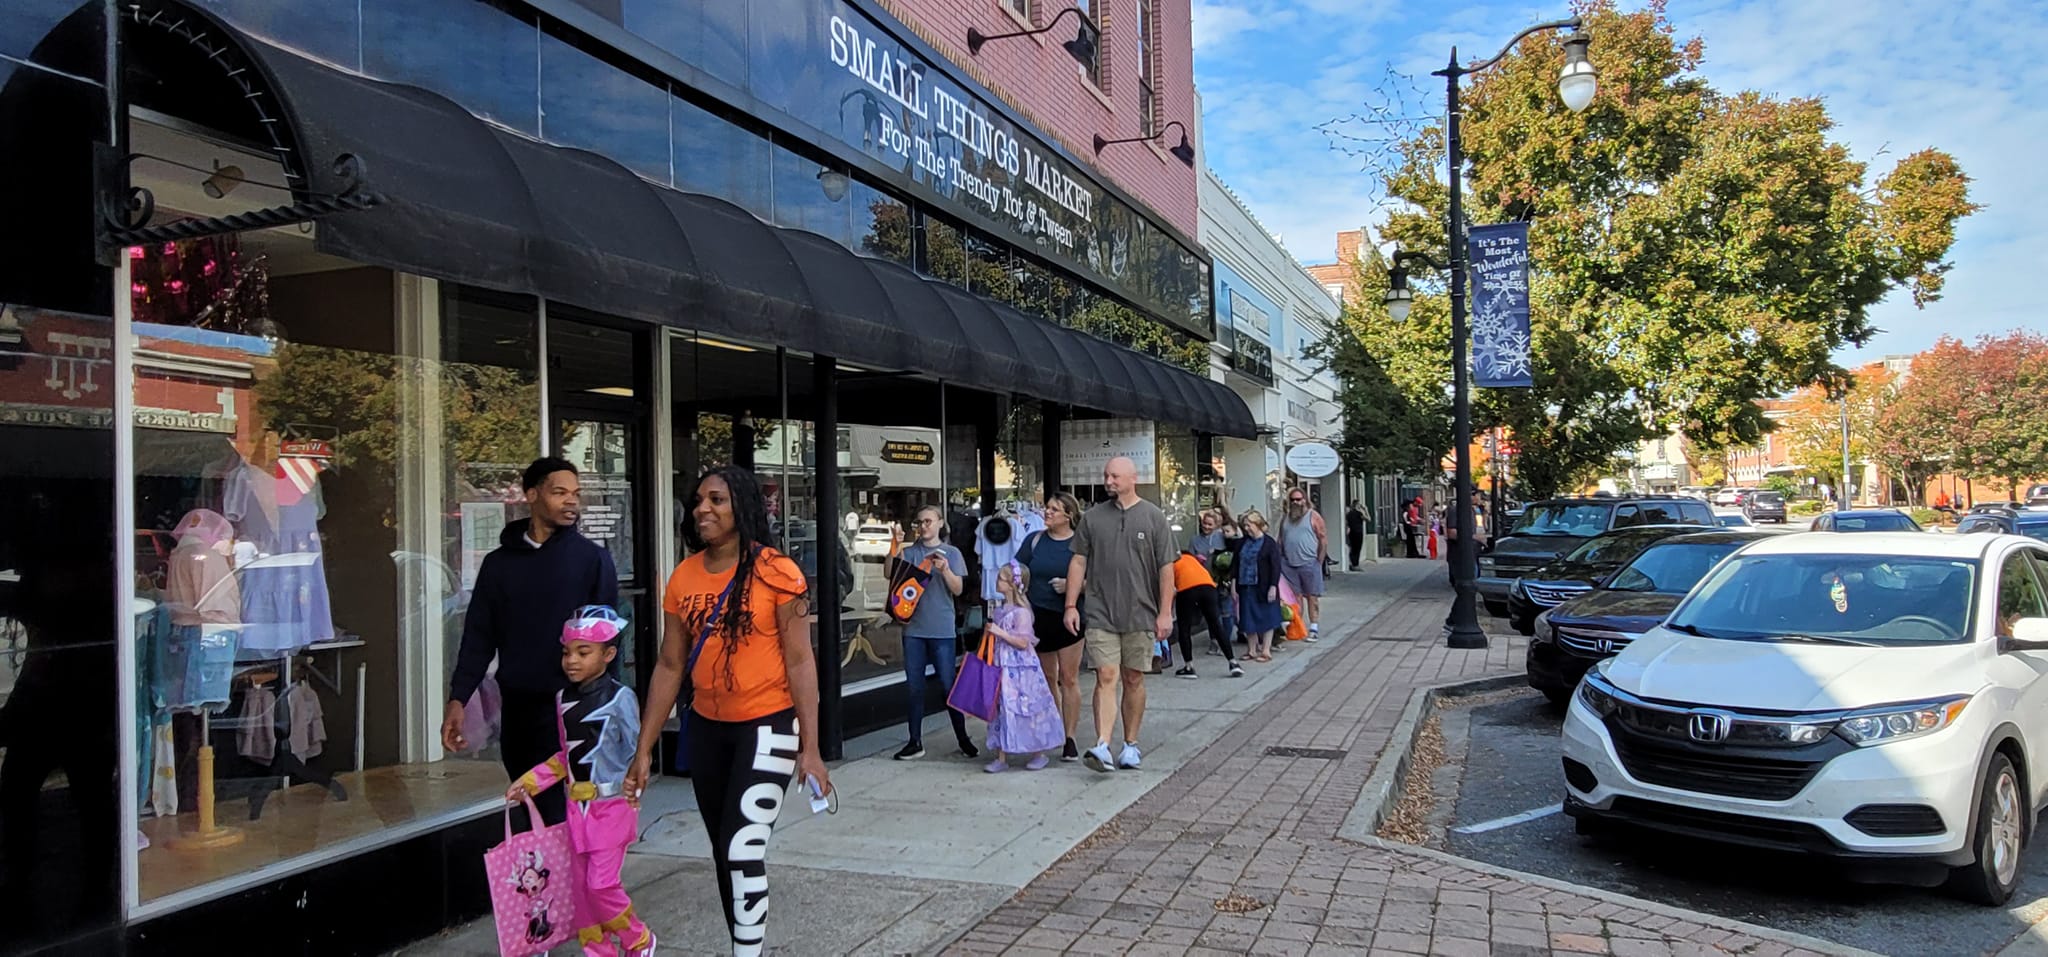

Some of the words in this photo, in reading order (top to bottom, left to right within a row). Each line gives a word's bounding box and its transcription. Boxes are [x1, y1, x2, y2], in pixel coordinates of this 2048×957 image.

[830, 15, 928, 120] SMALL
[934, 86, 1020, 176] THINGS
[1023, 147, 1093, 222] MARKET
[879, 112, 912, 159] For
[915, 139, 946, 179] The
[950, 156, 1000, 212] Trendy
[1003, 187, 1024, 221] Tot
[1026, 200, 1037, 225] &
[1039, 207, 1073, 248] Tween
[1471, 250, 1528, 273] Wonderful
[1478, 239, 1496, 248] It's
[1498, 237, 1520, 246] The
[1485, 247, 1512, 256] Most
[752, 717, 800, 775] IT.
[728, 782, 784, 861] DO
